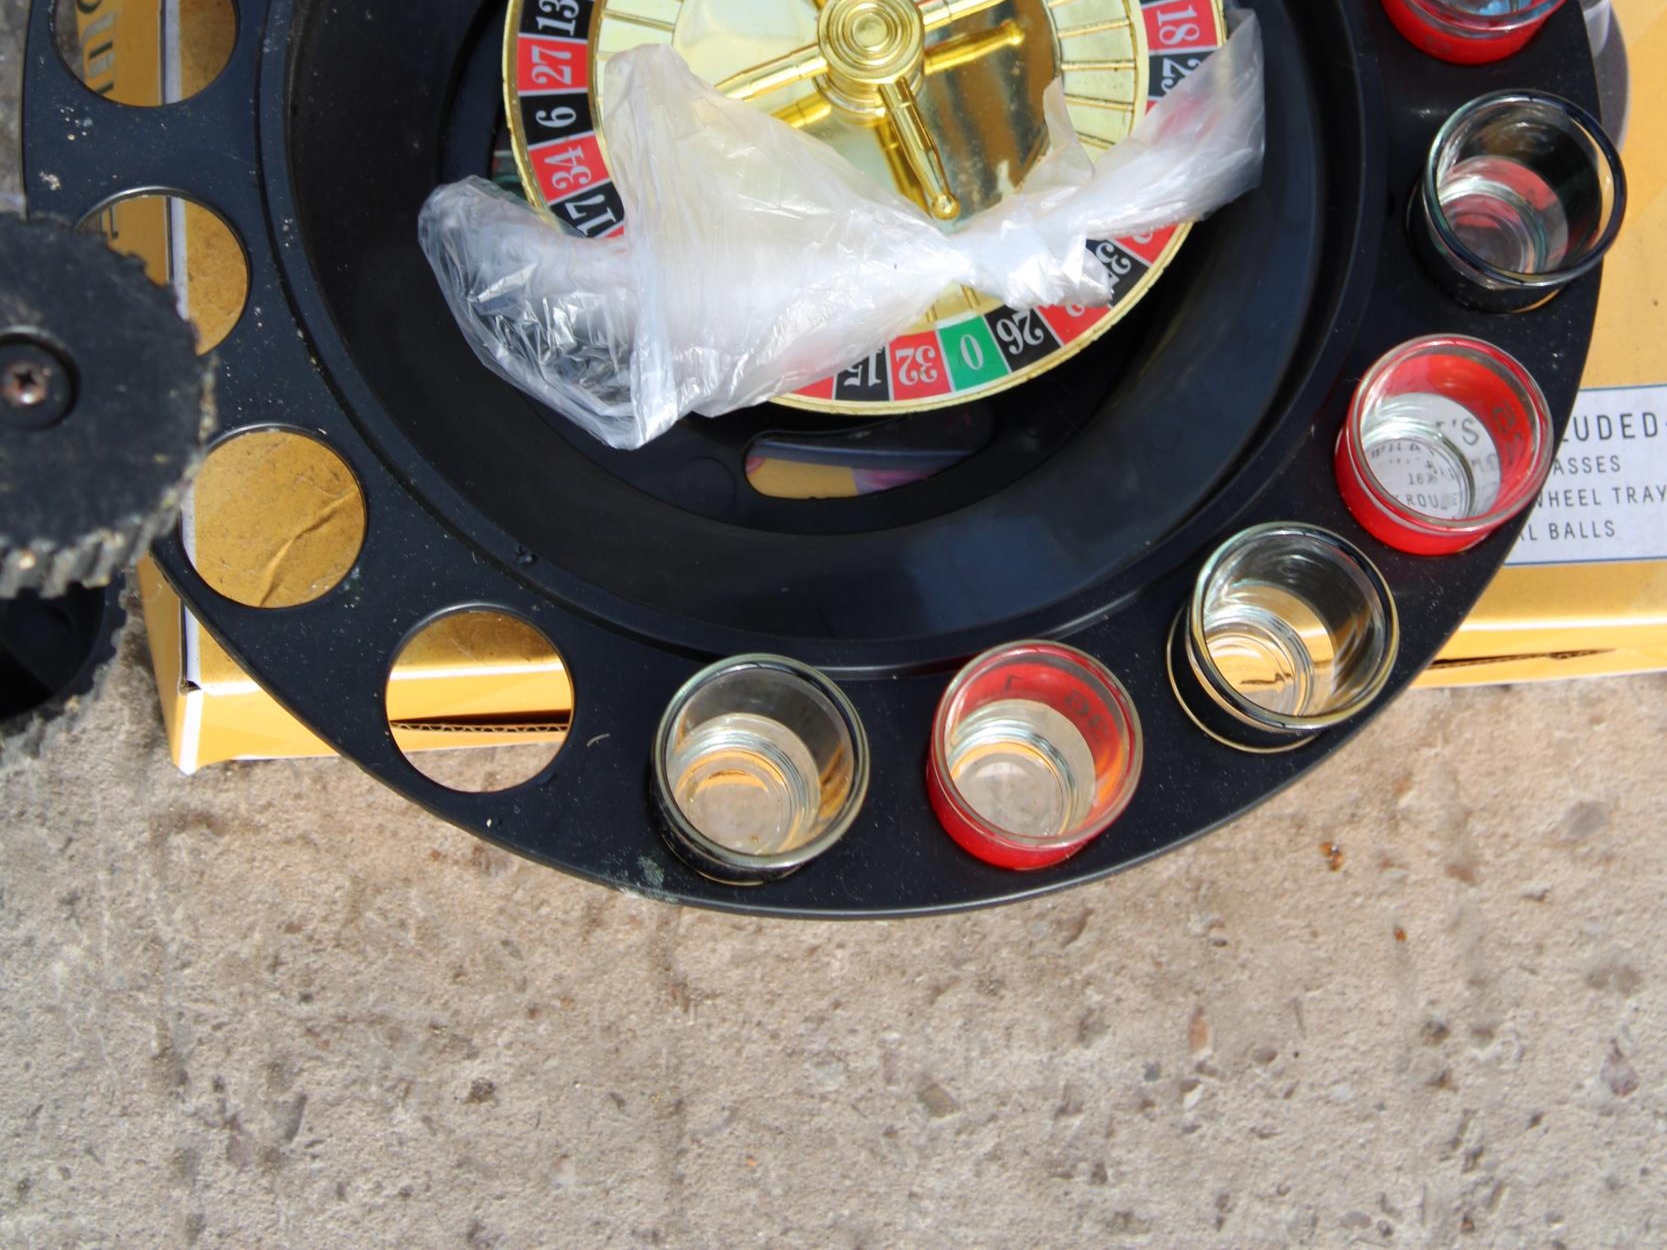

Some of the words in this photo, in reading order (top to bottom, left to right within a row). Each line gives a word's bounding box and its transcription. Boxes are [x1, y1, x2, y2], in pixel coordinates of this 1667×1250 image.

[1156, 5, 1201, 46] 18
[531, 44, 573, 86] 27
[534, 105, 577, 129] 6
[542, 144, 593, 190] 34
[564, 193, 617, 238] 17
[959, 333, 985, 371] 0
[996, 309, 1045, 356] 26
[895, 344, 939, 386] 32
[1552, 454, 1622, 476] ASSES
[1612, 484, 1667, 505] TRAY
[1548, 519, 1616, 540] BALLS
